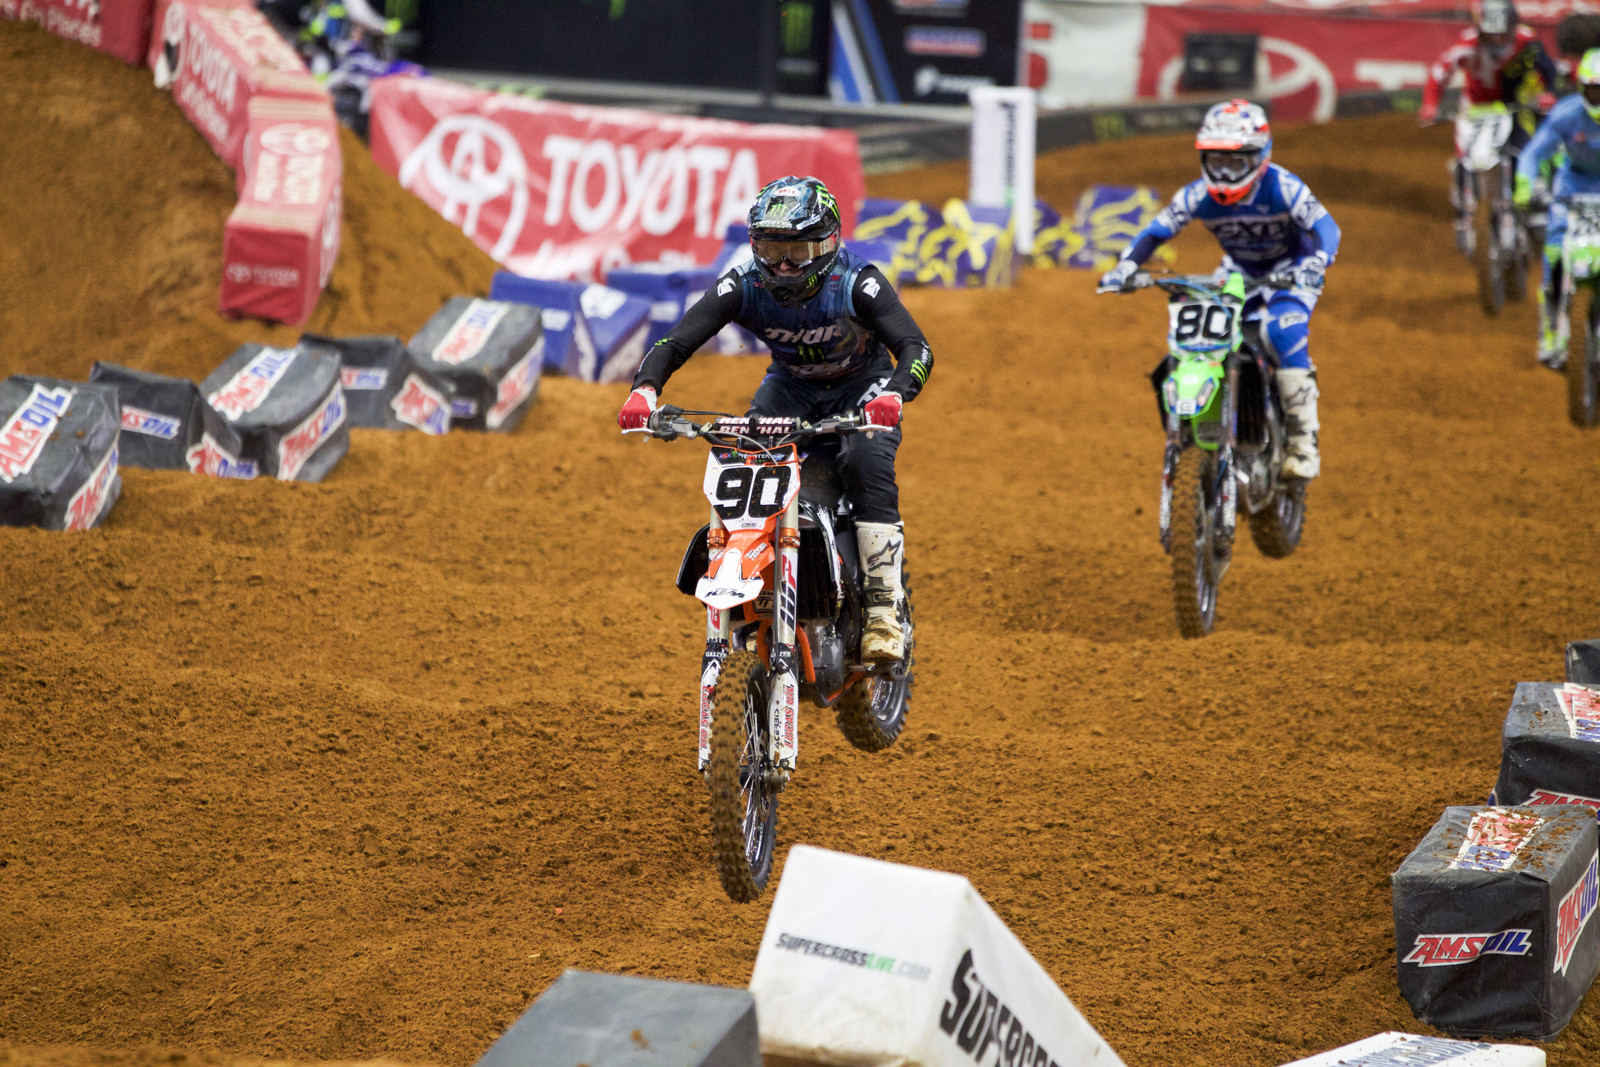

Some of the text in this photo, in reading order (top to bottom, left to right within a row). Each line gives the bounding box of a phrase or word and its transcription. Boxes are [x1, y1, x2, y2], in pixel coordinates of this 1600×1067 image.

[541, 134, 761, 240] TOYOTA
[764, 323, 843, 345] THOR
[1176, 304, 1235, 342] 80
[0, 386, 73, 481] AMSOIL
[719, 417, 793, 425] RENHAL
[720, 426, 791, 435] RENHAL
[713, 466, 792, 520] 90
[784, 706, 795, 749] LUCAS
[1554, 850, 1598, 975] AMSOIL
[1403, 930, 1532, 967] AMSOIL
